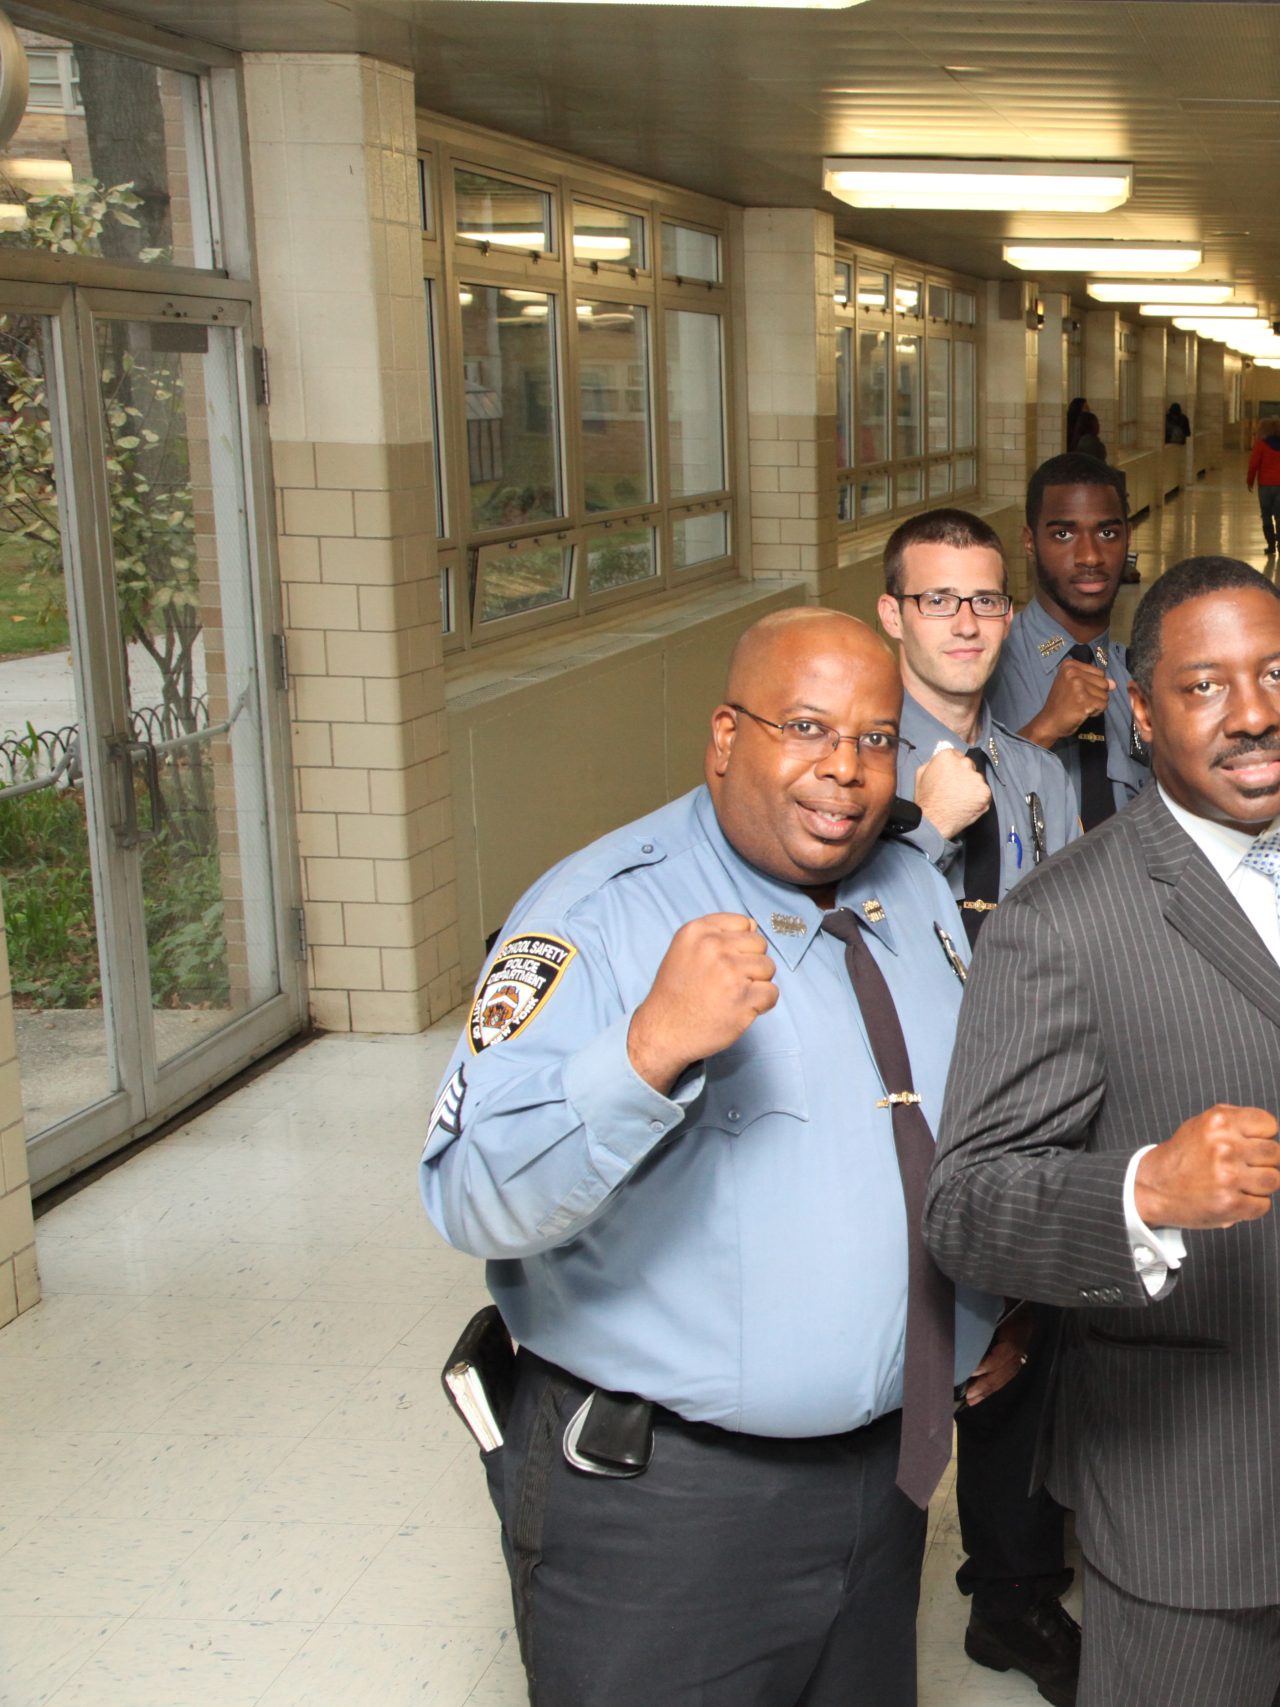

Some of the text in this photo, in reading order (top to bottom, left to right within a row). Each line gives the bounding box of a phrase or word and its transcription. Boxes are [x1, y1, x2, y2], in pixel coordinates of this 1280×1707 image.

[530, 941, 569, 963] SAFETY
[504, 958, 541, 973] POLICE
[487, 969, 547, 989] DEPARTMENT
[472, 998, 482, 1040] CITY OF
[512, 997, 539, 1025] YORK
